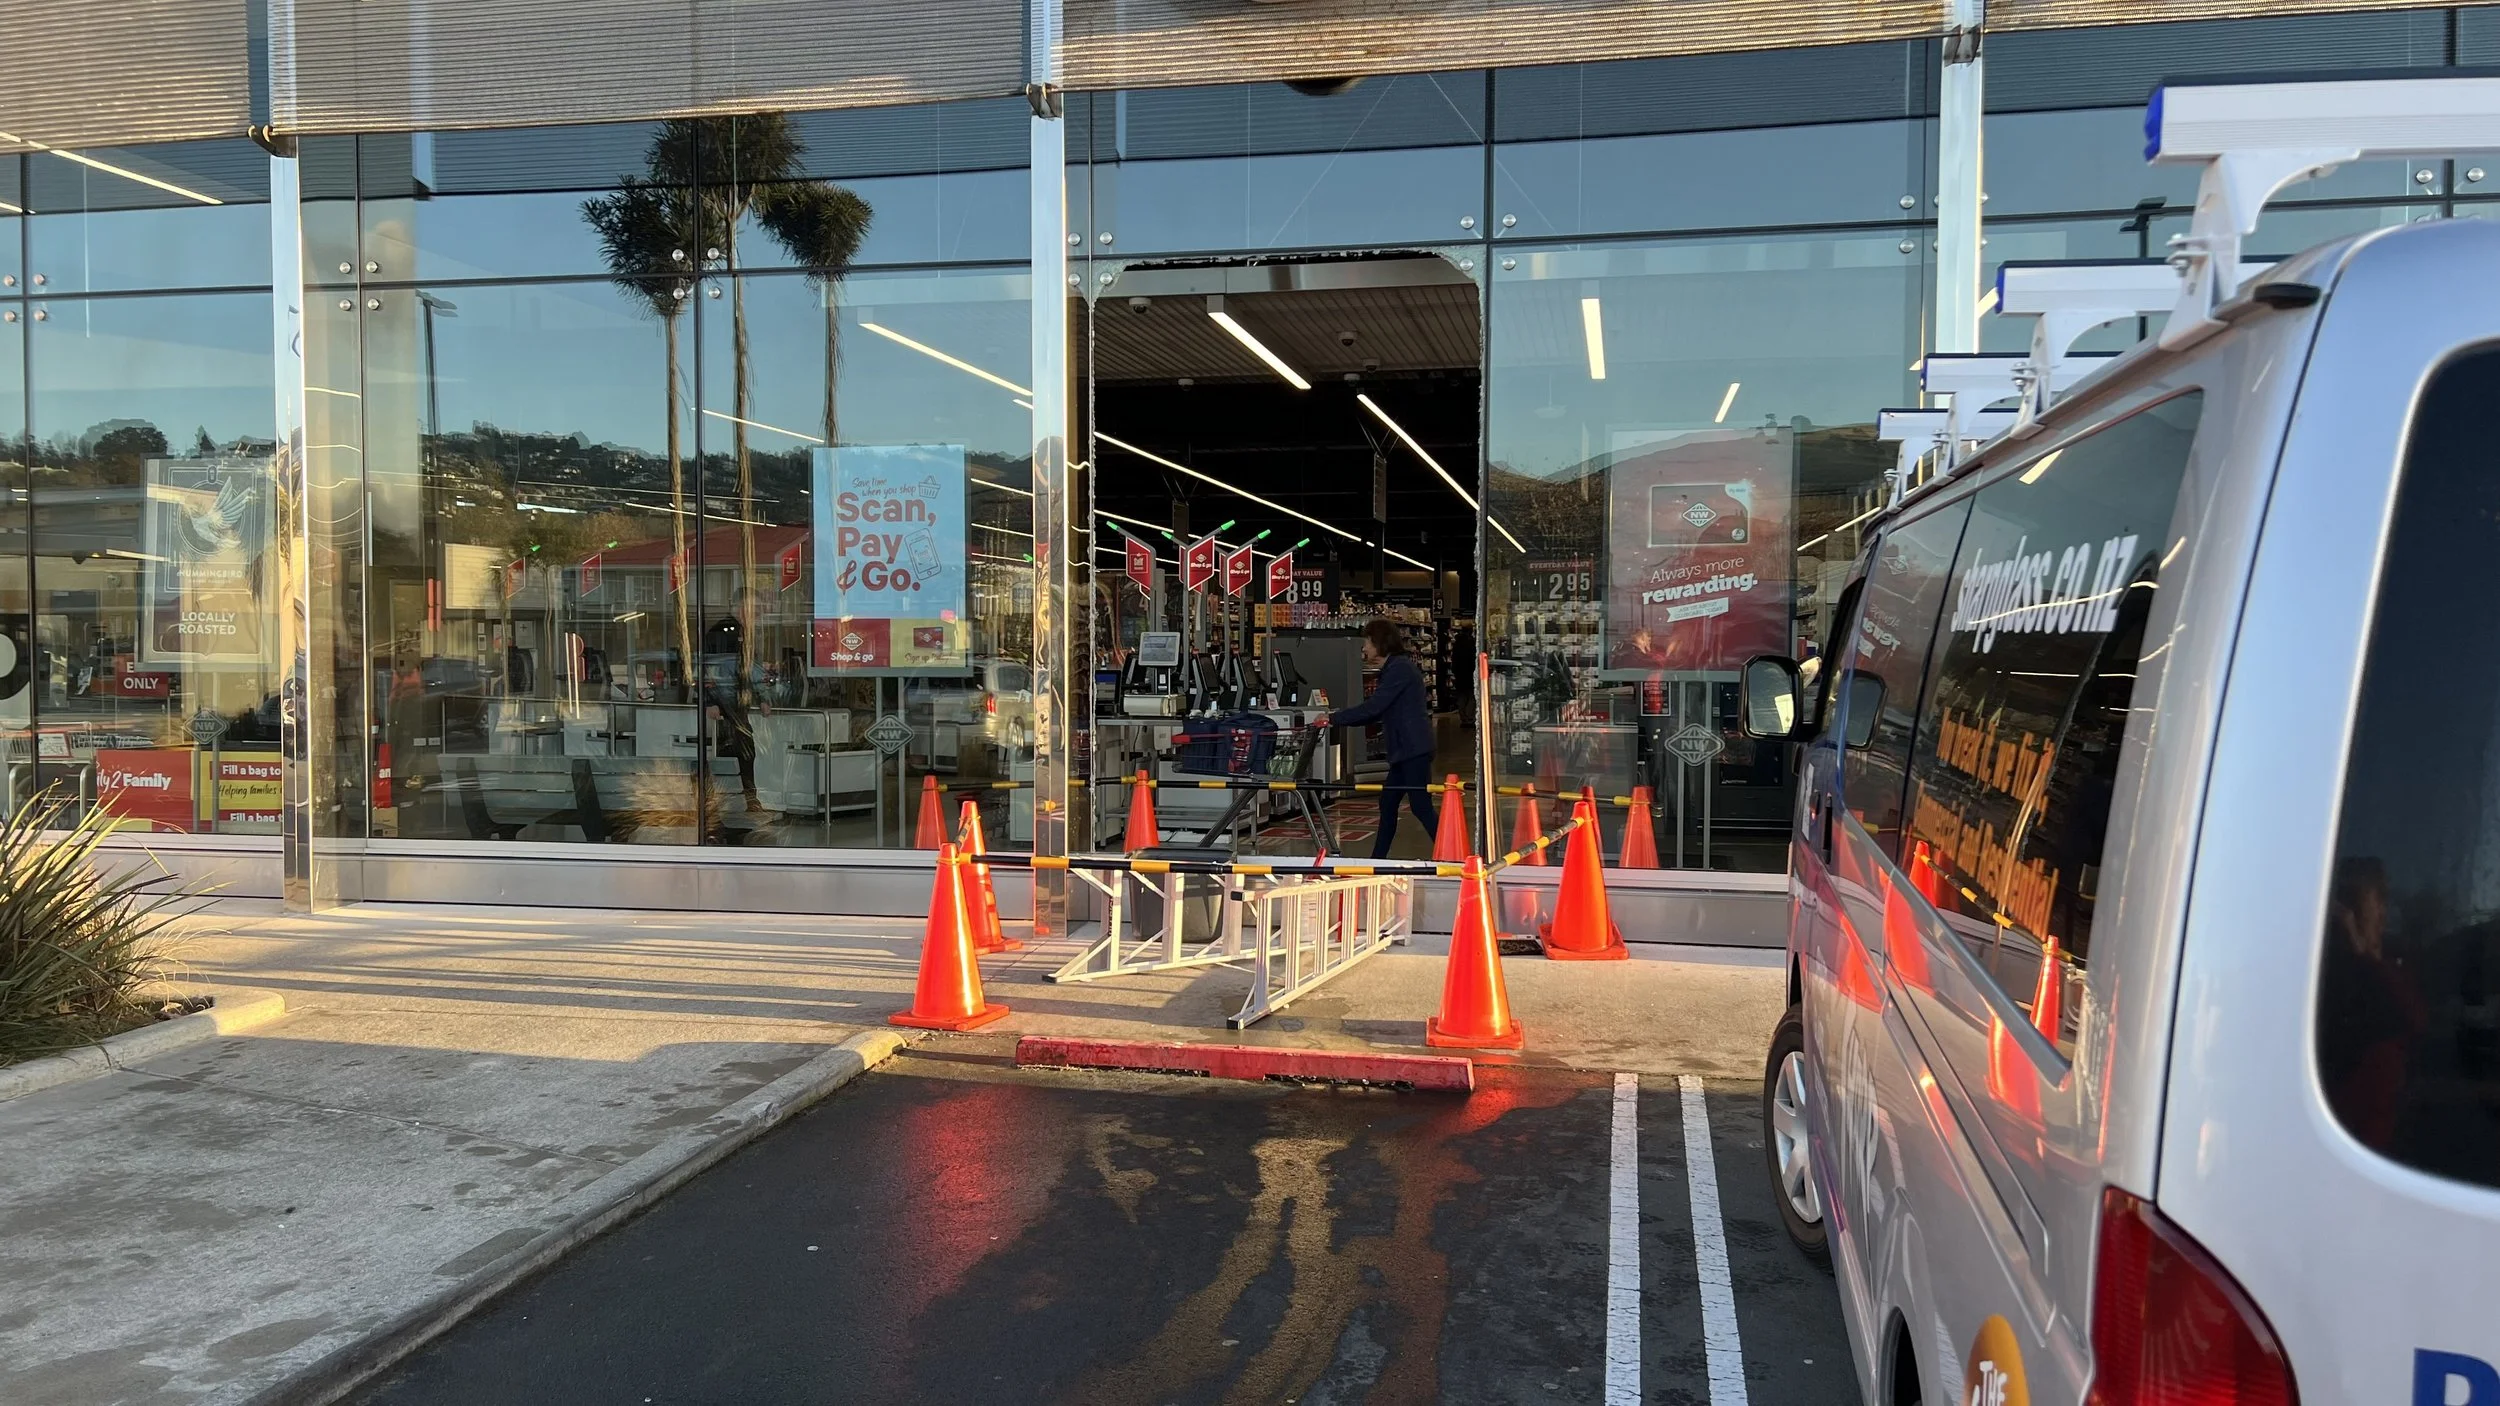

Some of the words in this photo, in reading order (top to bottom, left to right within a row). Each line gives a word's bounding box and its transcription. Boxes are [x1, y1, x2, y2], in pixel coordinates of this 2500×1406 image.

[852, 477, 870, 488] Save
[861, 487, 881, 497] when
[883, 487, 897, 499] you
[899, 483, 917, 496] shop
[836, 491, 937, 527] Scan,
[837, 526, 904, 565] Pay
[861, 560, 921, 592] Go.
[1650, 564, 1702, 583] Always
[1705, 557, 1745, 573] more
[1642, 572, 1758, 605] rewarding.
[1951, 534, 2139, 654] sharpglass.co.nz
[181, 611, 236, 623] LOCALLY
[178, 624, 237, 636] ROASTED
[830, 651, 853, 663] Shop
[853, 652, 861, 661] &
[862, 653, 874, 663] go
[123, 677, 159, 690] ONLY
[194, 721, 216, 731] NW
[877, 729, 903, 740] NW
[1681, 739, 1709, 750] NW
[222, 764, 238, 775] Fill
[240, 767, 247, 775] a
[248, 764, 268, 777] bag
[110, 770, 122, 789] 2
[122, 772, 172, 791] Family
[218, 784, 248, 799] Helping
[249, 783, 277, 796] families
[230, 812, 246, 821] Fill
